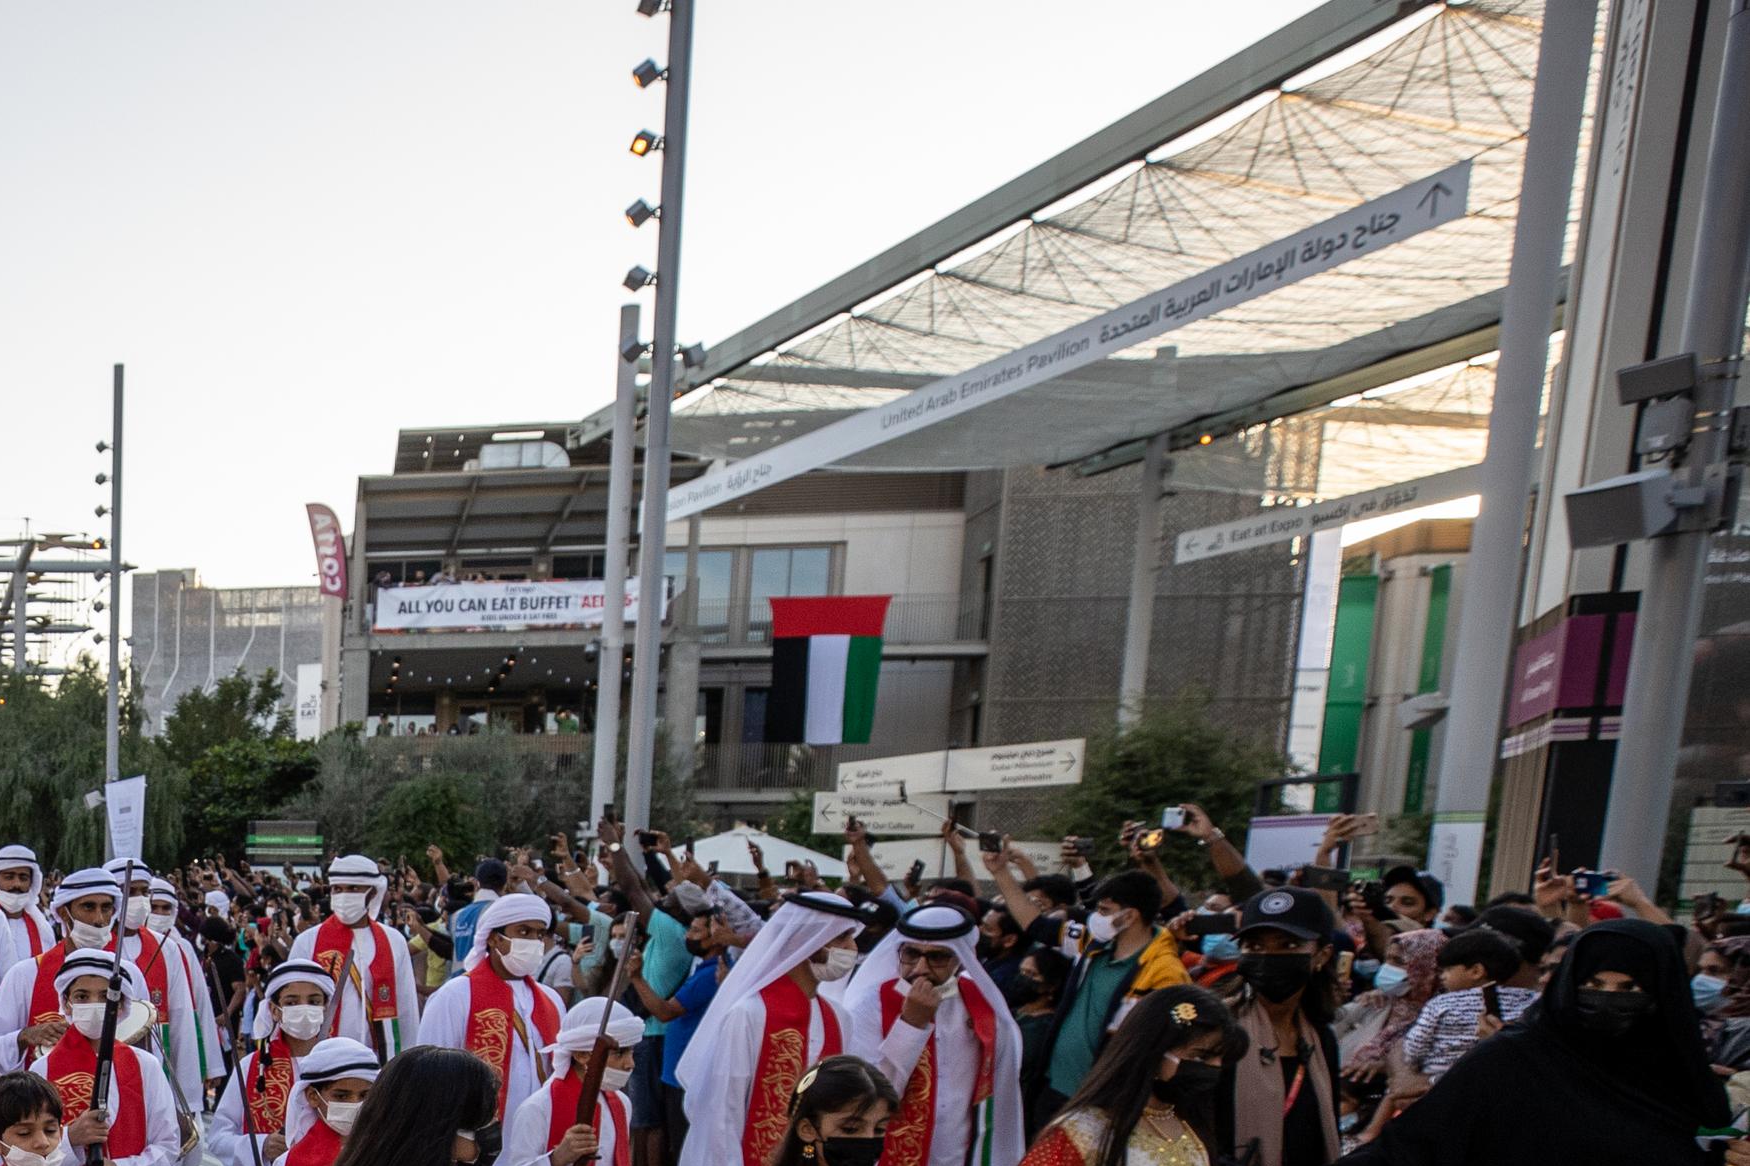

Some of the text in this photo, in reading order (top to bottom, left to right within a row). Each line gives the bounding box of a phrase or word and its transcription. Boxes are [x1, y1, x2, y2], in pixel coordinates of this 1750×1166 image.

[1099, 211, 1401, 344] جناح دولة الإمارات العربية المتحدة
[881, 336, 1090, 429] United Arab Emirates Pavilion
[688, 483, 722, 503] Pavilion
[1230, 529, 1252, 543] Eat
[1270, 518, 1303, 536] Expo
[398, 601, 422, 614] ALL
[426, 599, 451, 614] YOU
[460, 598, 486, 612] CAN
[491, 597, 515, 611] EAT
[520, 595, 571, 611] BUFFET
